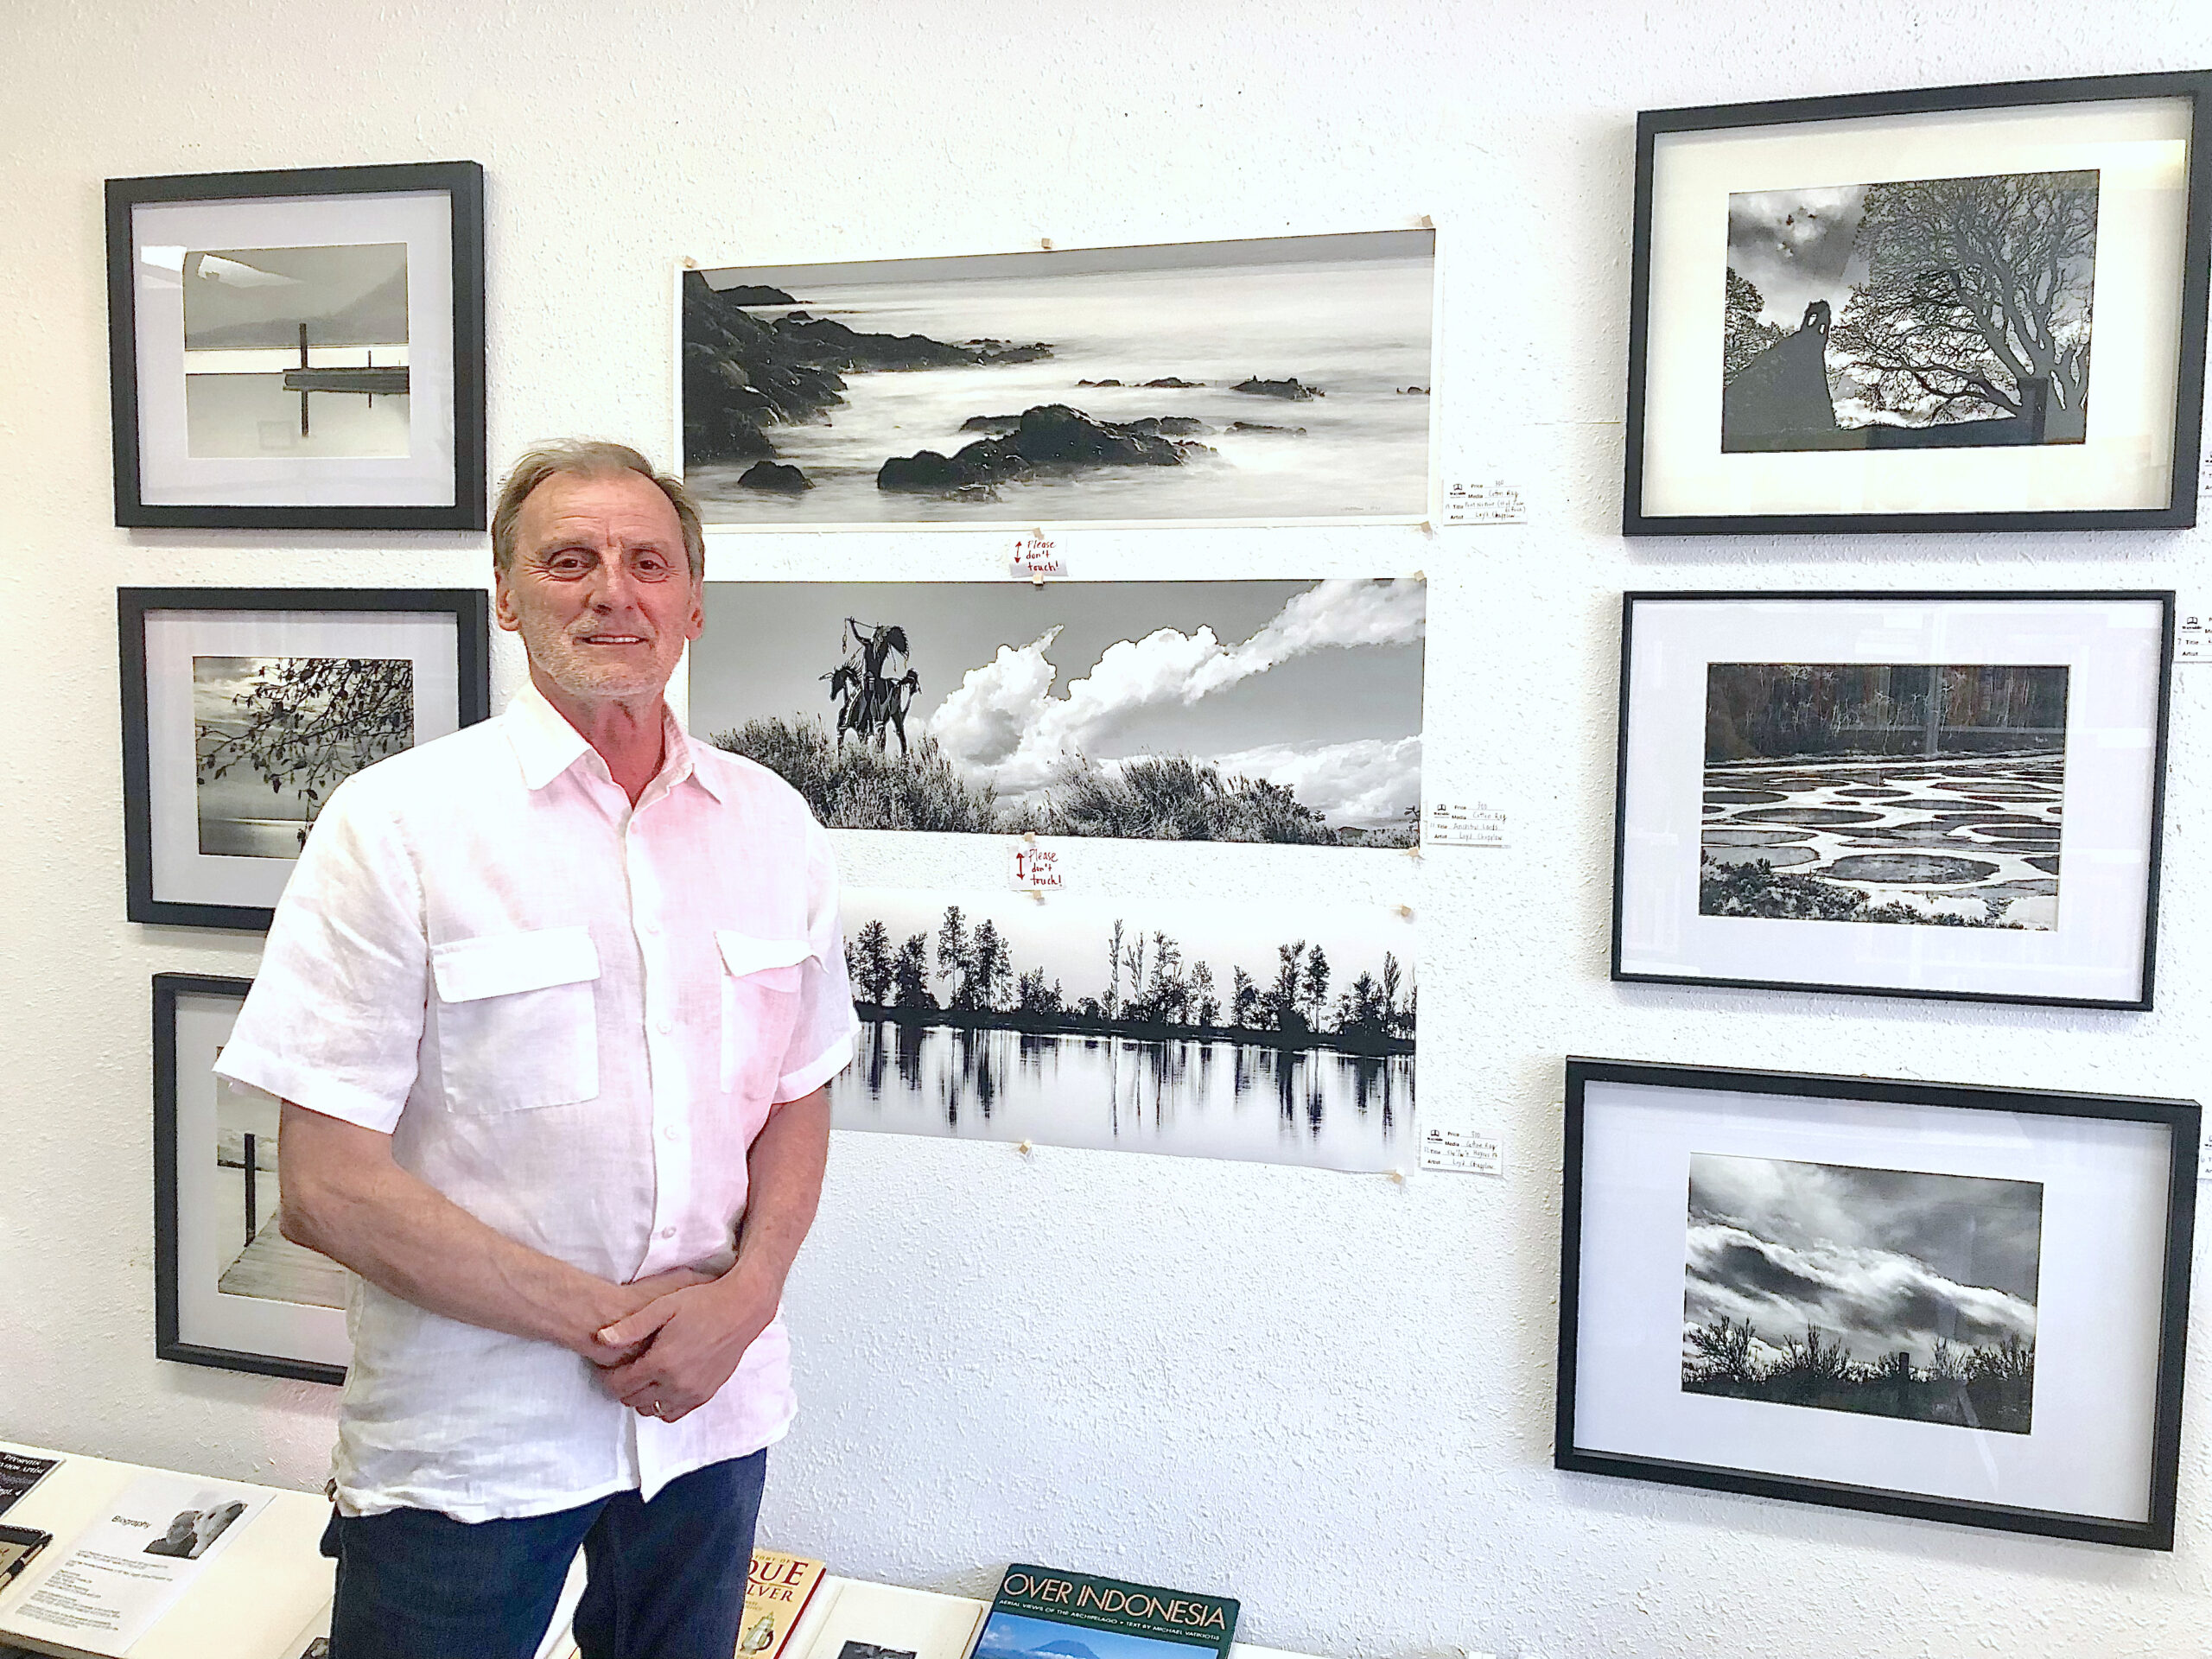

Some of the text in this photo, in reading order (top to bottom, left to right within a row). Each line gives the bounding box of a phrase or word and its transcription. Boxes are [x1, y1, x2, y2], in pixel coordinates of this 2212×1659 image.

[1027, 540, 1057, 549] Please
[1026, 550, 1052, 560] don't
[1027, 560, 1059, 572] touch!
[1028, 849, 1058, 862] Please
[1031, 862, 1052, 873] don't
[1030, 874, 1063, 887] touch!
[111, 1516, 152, 1529] Biography
[1003, 1573, 1226, 1630] OVER INDONESIA
[1022, 1603, 1045, 1612] VIEWS
[1070, 1611, 1118, 1624] ARCHIPELAGO
[1126, 1621, 1141, 1630] TEXT
[1152, 1624, 1184, 1636] MICHAEL
